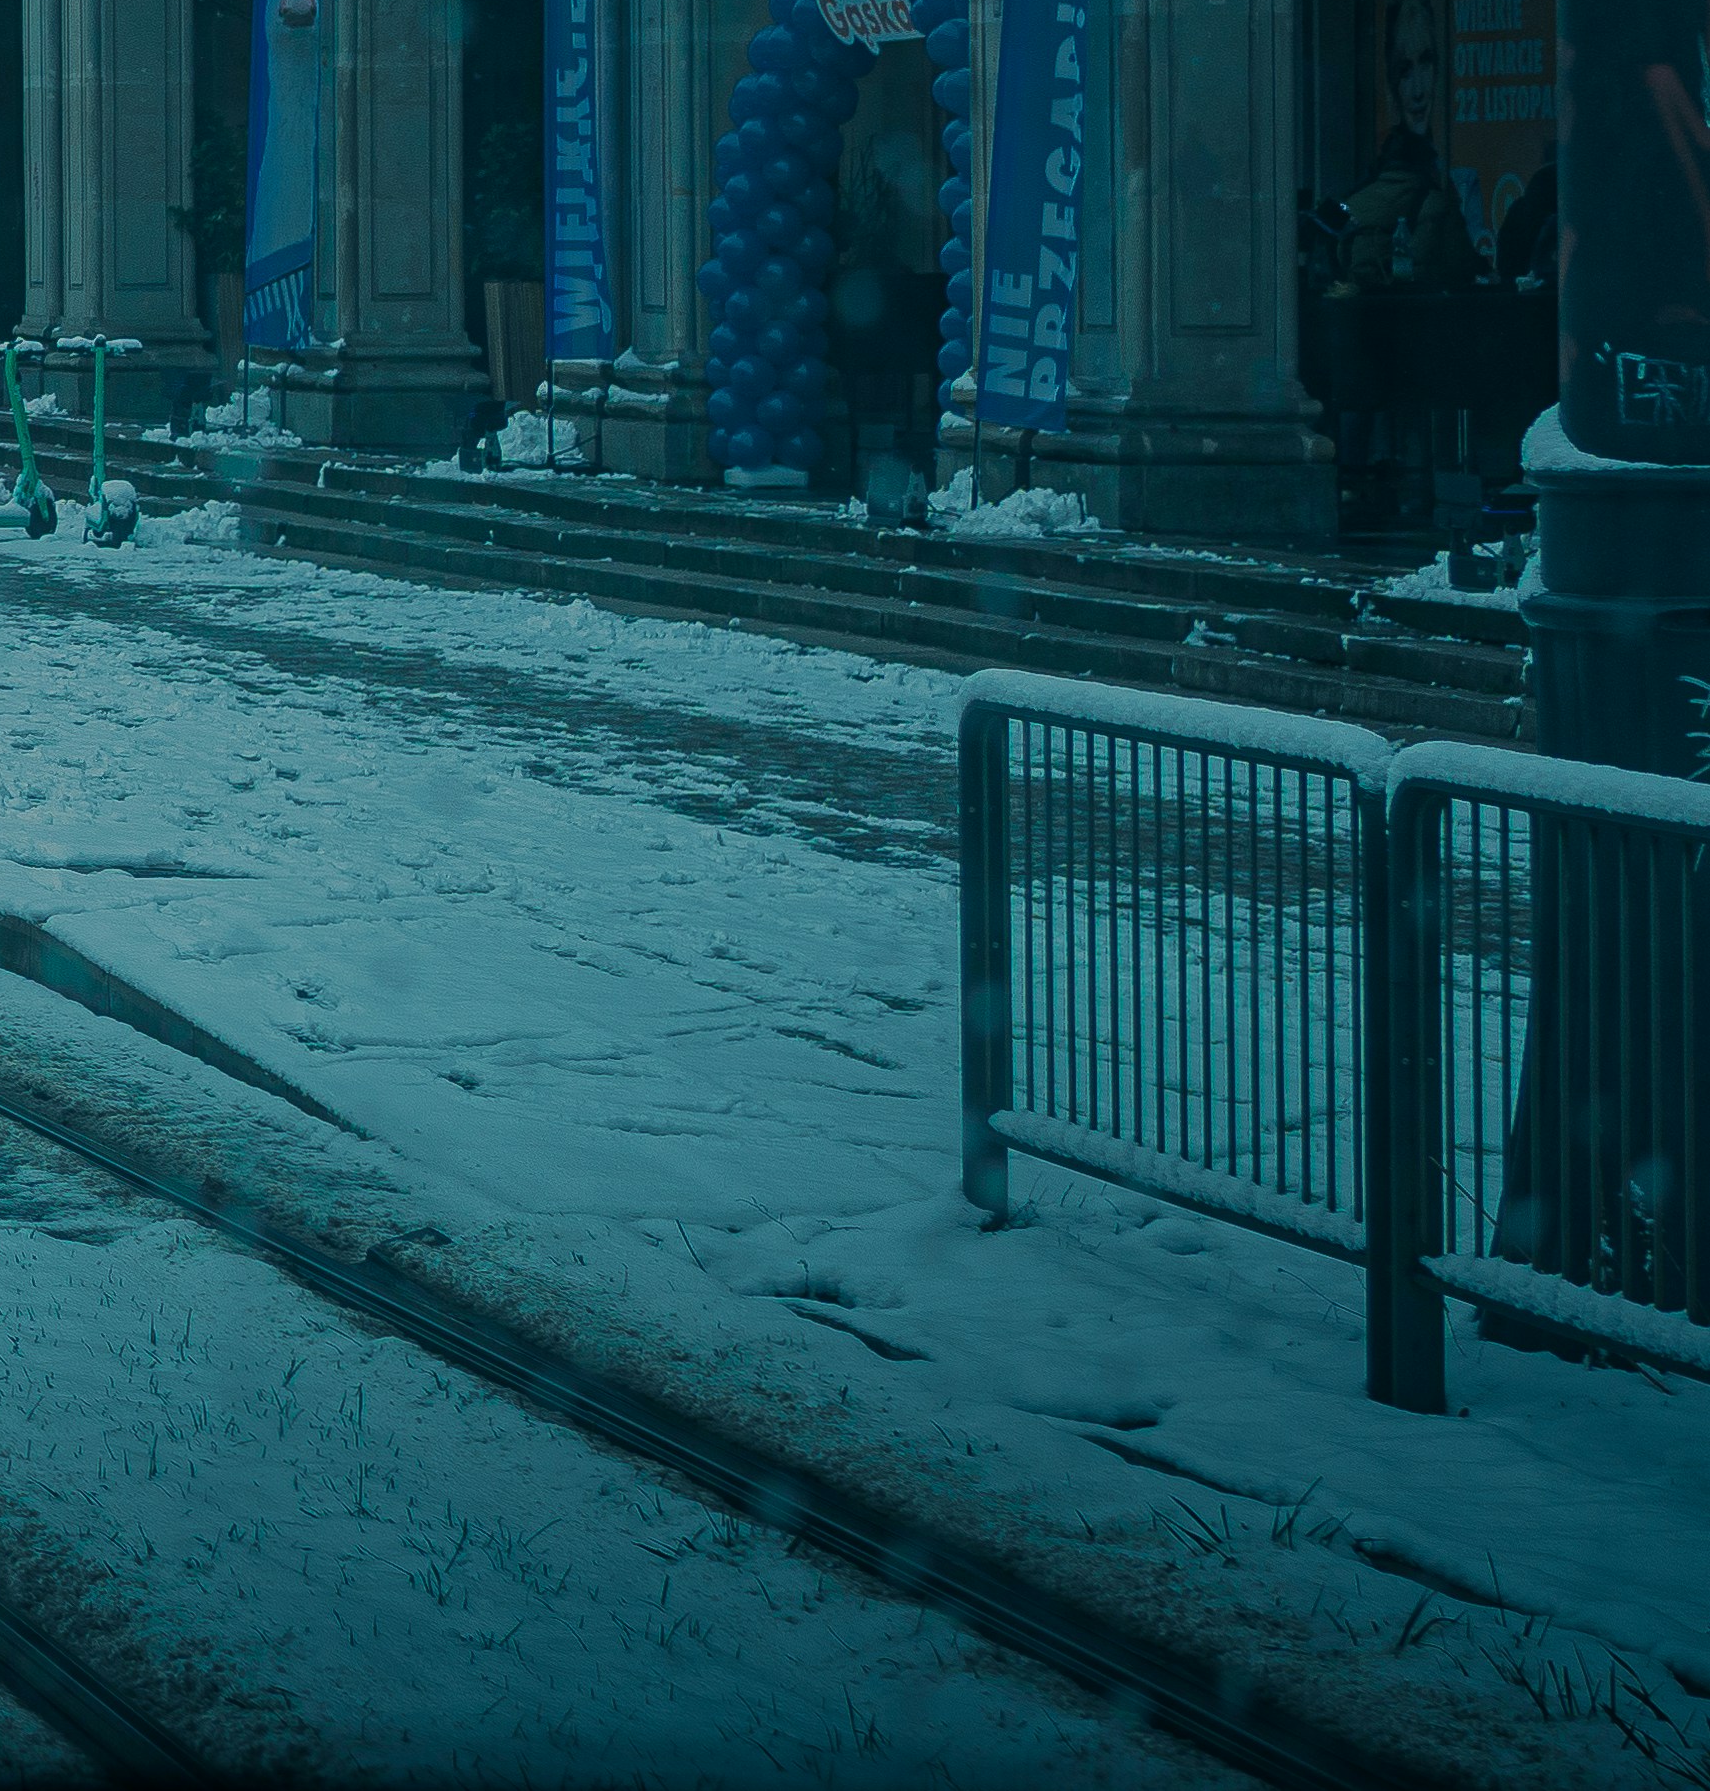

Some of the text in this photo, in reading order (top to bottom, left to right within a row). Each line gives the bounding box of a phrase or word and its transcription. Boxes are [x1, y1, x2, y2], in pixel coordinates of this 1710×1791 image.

[1453, 39, 1544, 77] OTWARCIE
[1454, 86, 1479, 123] 22
[984, 267, 1034, 399] NIE
